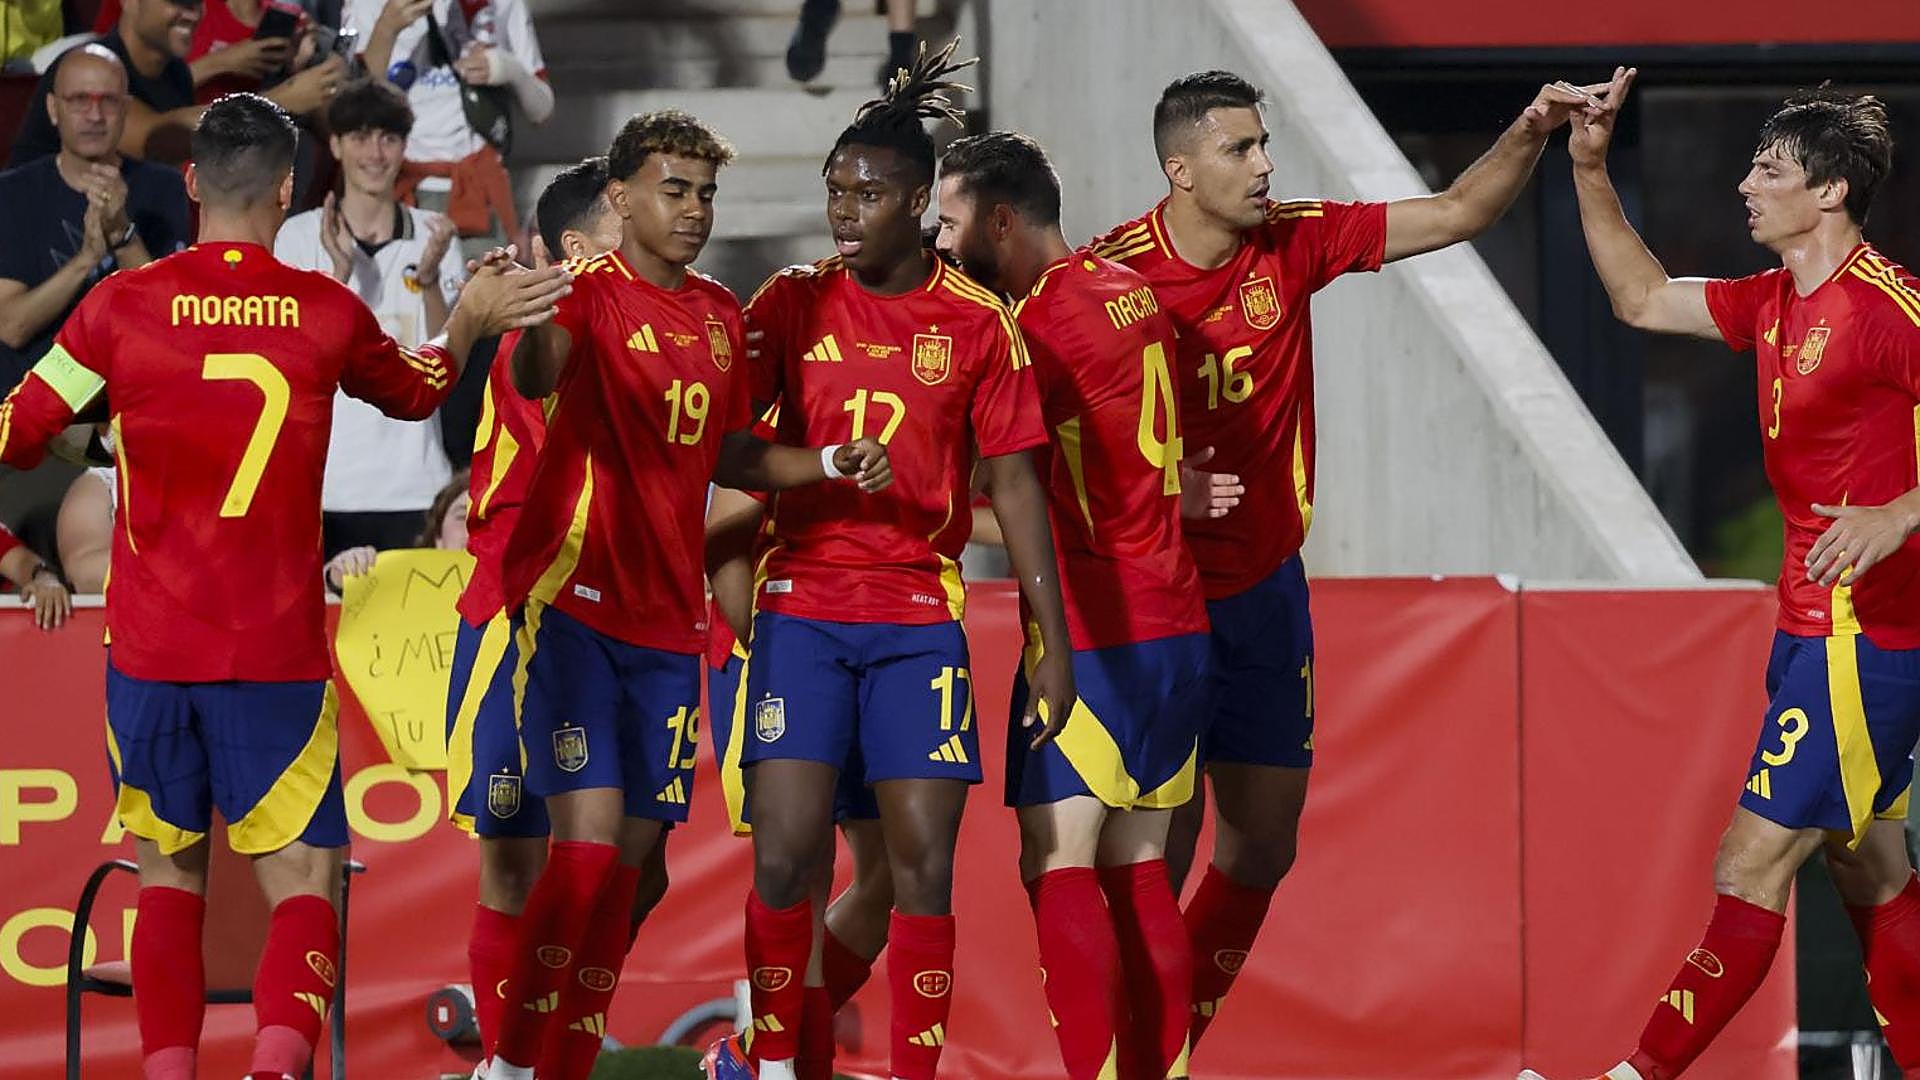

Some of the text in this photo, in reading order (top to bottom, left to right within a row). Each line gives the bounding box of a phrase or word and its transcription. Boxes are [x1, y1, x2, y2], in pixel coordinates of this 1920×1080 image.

[171, 294, 300, 328] MORATA
[1104, 286, 1159, 330] NACHO
[1197, 345, 1254, 410] 16
[1768, 377, 1783, 440] 3
[202, 353, 291, 517] 7
[664, 379, 710, 446] 19
[843, 388, 906, 446] 17
[1137, 341, 1184, 496] 4
[930, 666, 973, 732] 17
[667, 706, 700, 770] 19
[1760, 707, 1810, 767] 3
